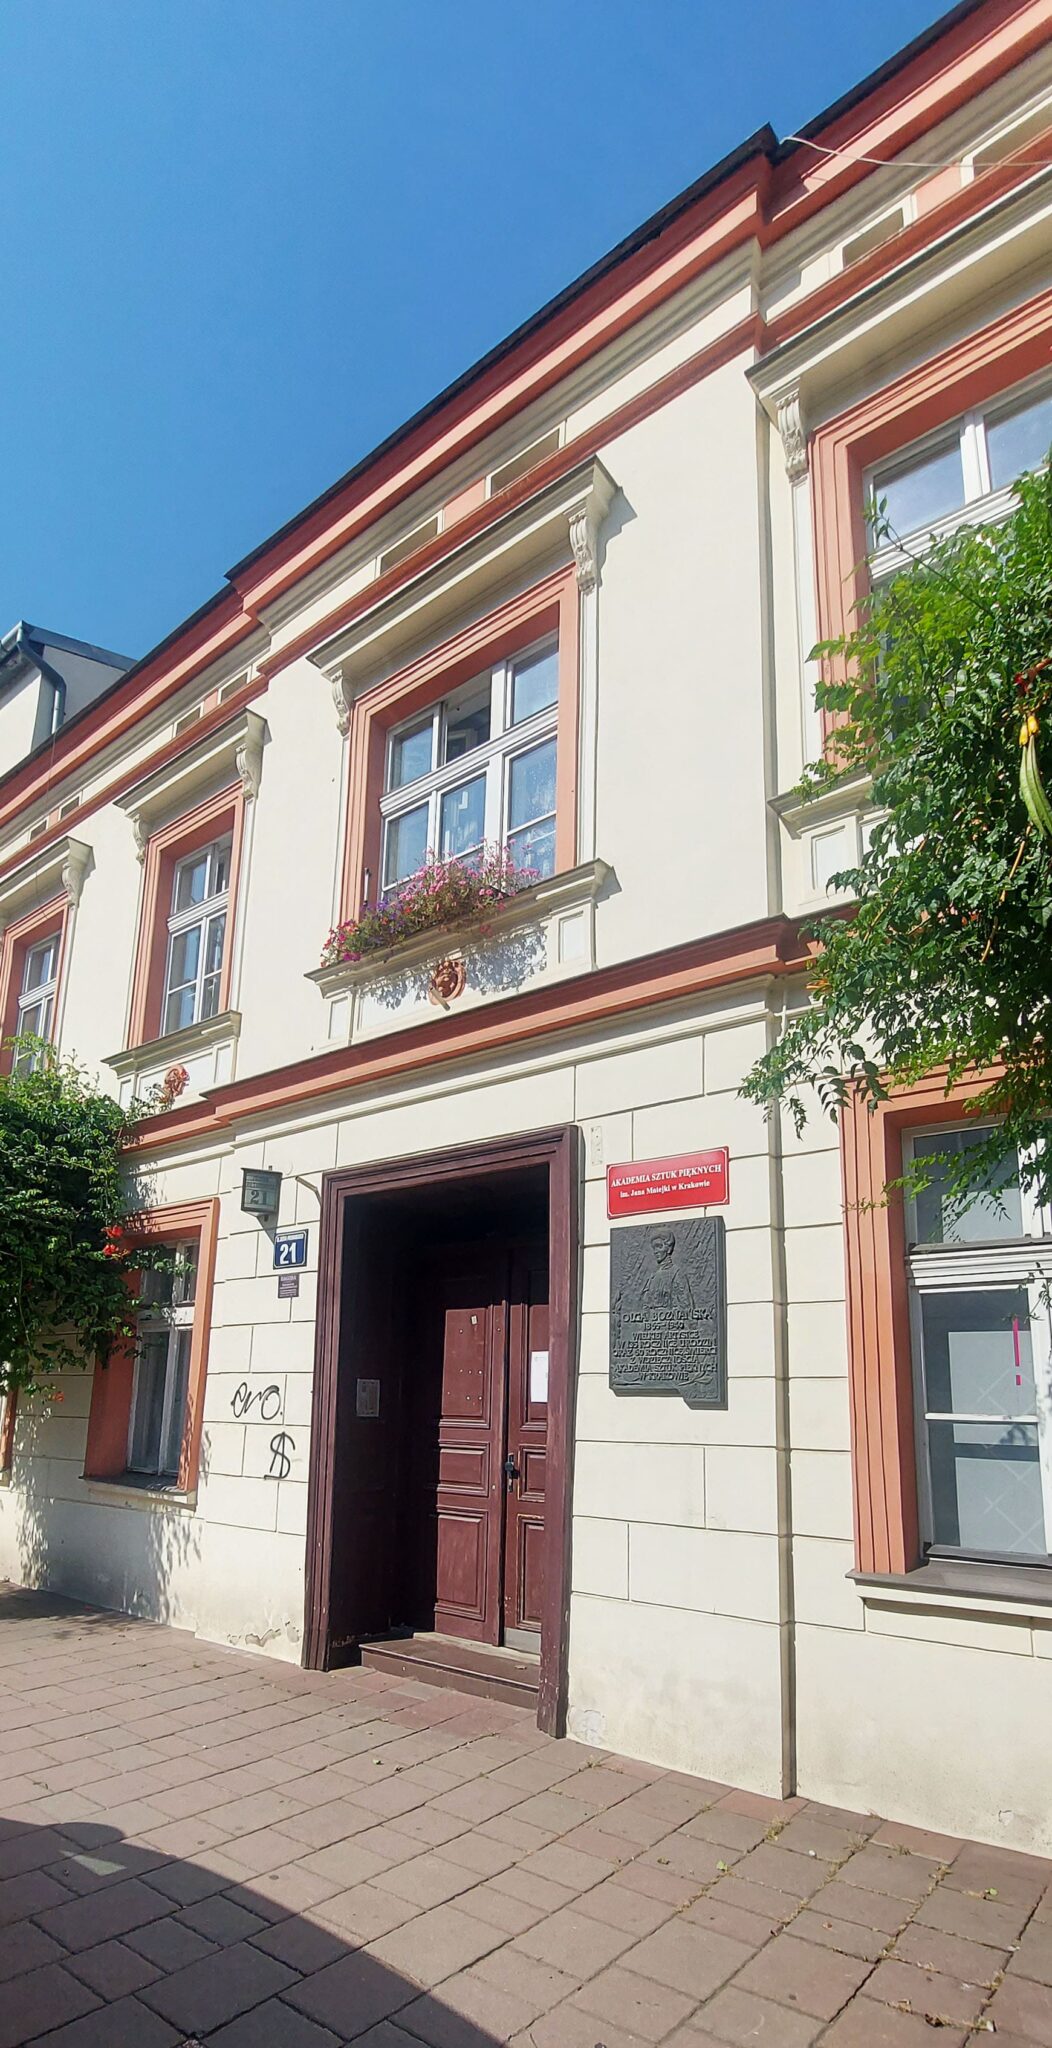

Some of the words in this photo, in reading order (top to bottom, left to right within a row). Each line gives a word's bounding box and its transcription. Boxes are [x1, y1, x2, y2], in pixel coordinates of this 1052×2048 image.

[611, 1174, 651, 1188] AKADEMIA
[651, 1171, 677, 1182] SZTUK
[679, 1164, 722, 1179] PIĘKNYCH
[250, 1190, 268, 1206] 21
[620, 1190, 630, 1198] im.
[631, 1189, 645, 1197] Jana
[646, 1185, 671, 1195] Matejki
[678, 1180, 711, 1190] Krakowie
[280, 1242, 297, 1265] 21
[623, 1311, 648, 1323] OLGA
